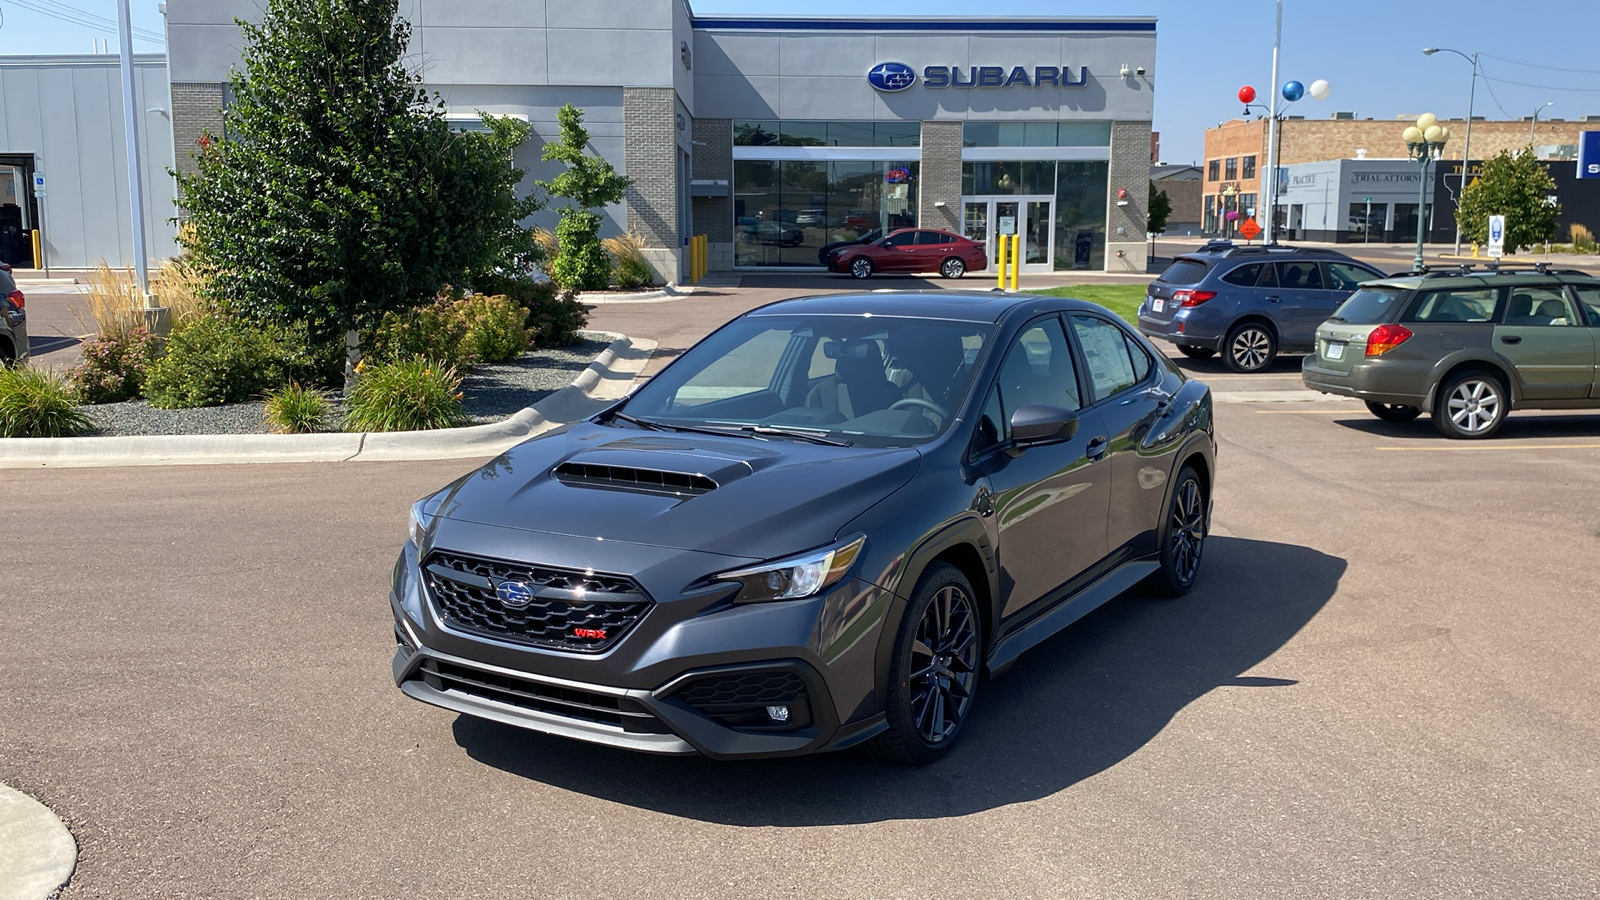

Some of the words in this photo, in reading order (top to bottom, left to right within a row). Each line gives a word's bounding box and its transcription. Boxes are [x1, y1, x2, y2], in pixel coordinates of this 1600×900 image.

[924, 66, 1088, 87] SUBARU
[1588, 164, 1600, 173] S
[887, 170, 906, 179] OPEN
[1293, 175, 1316, 185] PRACTICE
[575, 629, 607, 639] WRX
